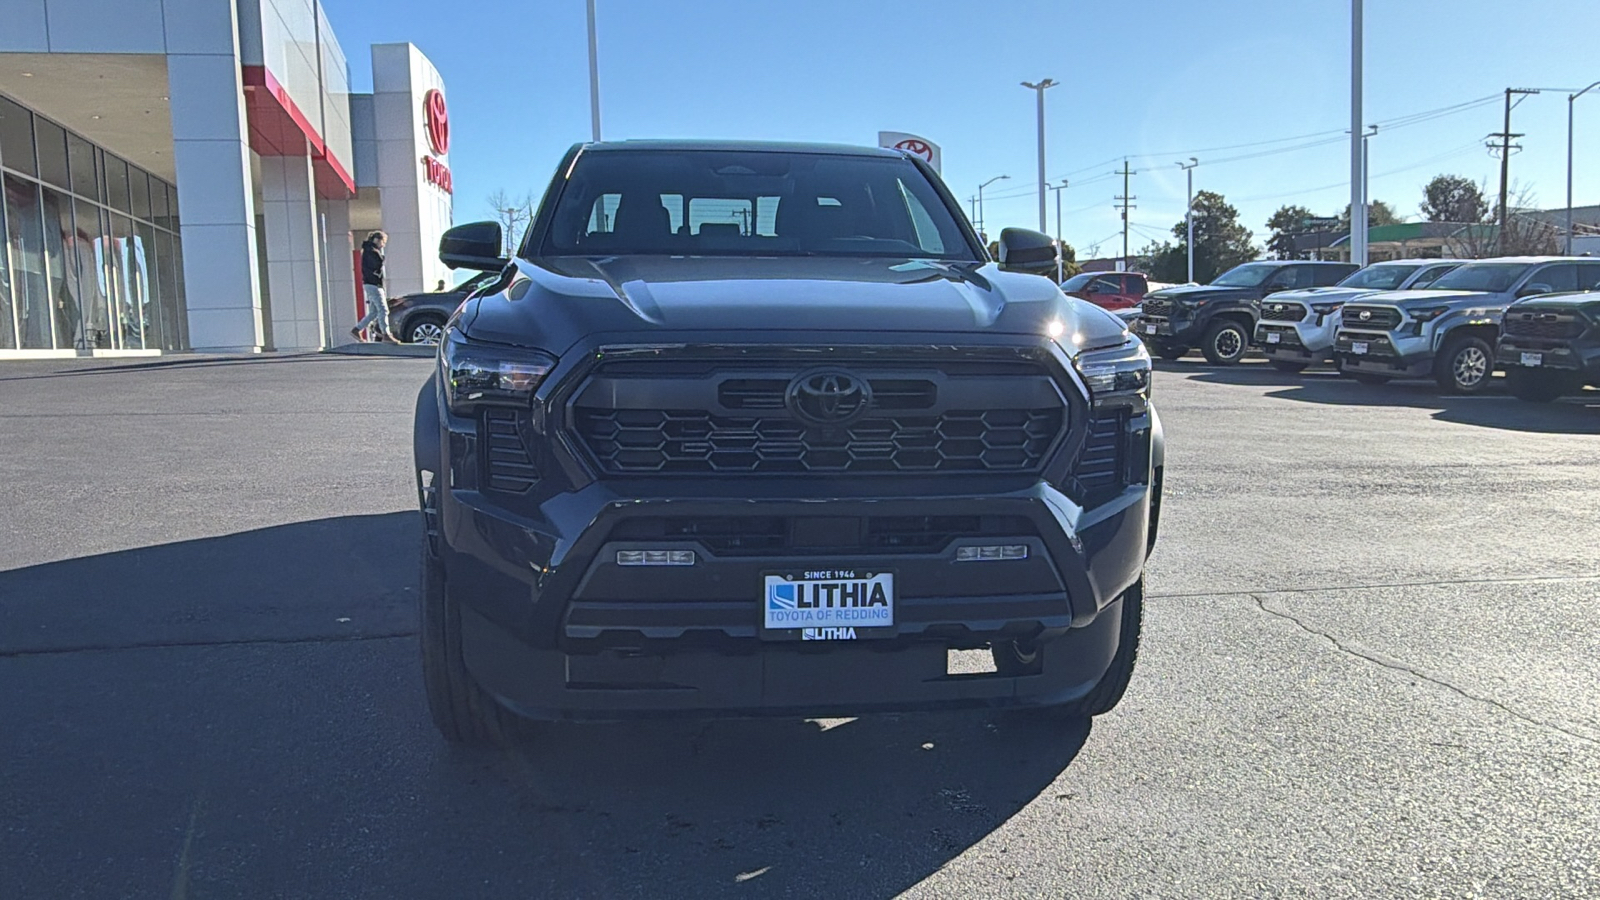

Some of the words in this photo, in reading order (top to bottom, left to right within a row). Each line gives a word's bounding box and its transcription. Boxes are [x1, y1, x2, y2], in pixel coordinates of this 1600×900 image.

[424, 155, 453, 195] TOYO
[804, 571, 831, 579] SINCE
[834, 570, 855, 578] 1946
[797, 582, 888, 608] LITHIA
[769, 610, 813, 622] TOYOTA
[816, 609, 832, 620] OF
[835, 608, 889, 620] REDDING
[814, 627, 857, 640] LITHIA
